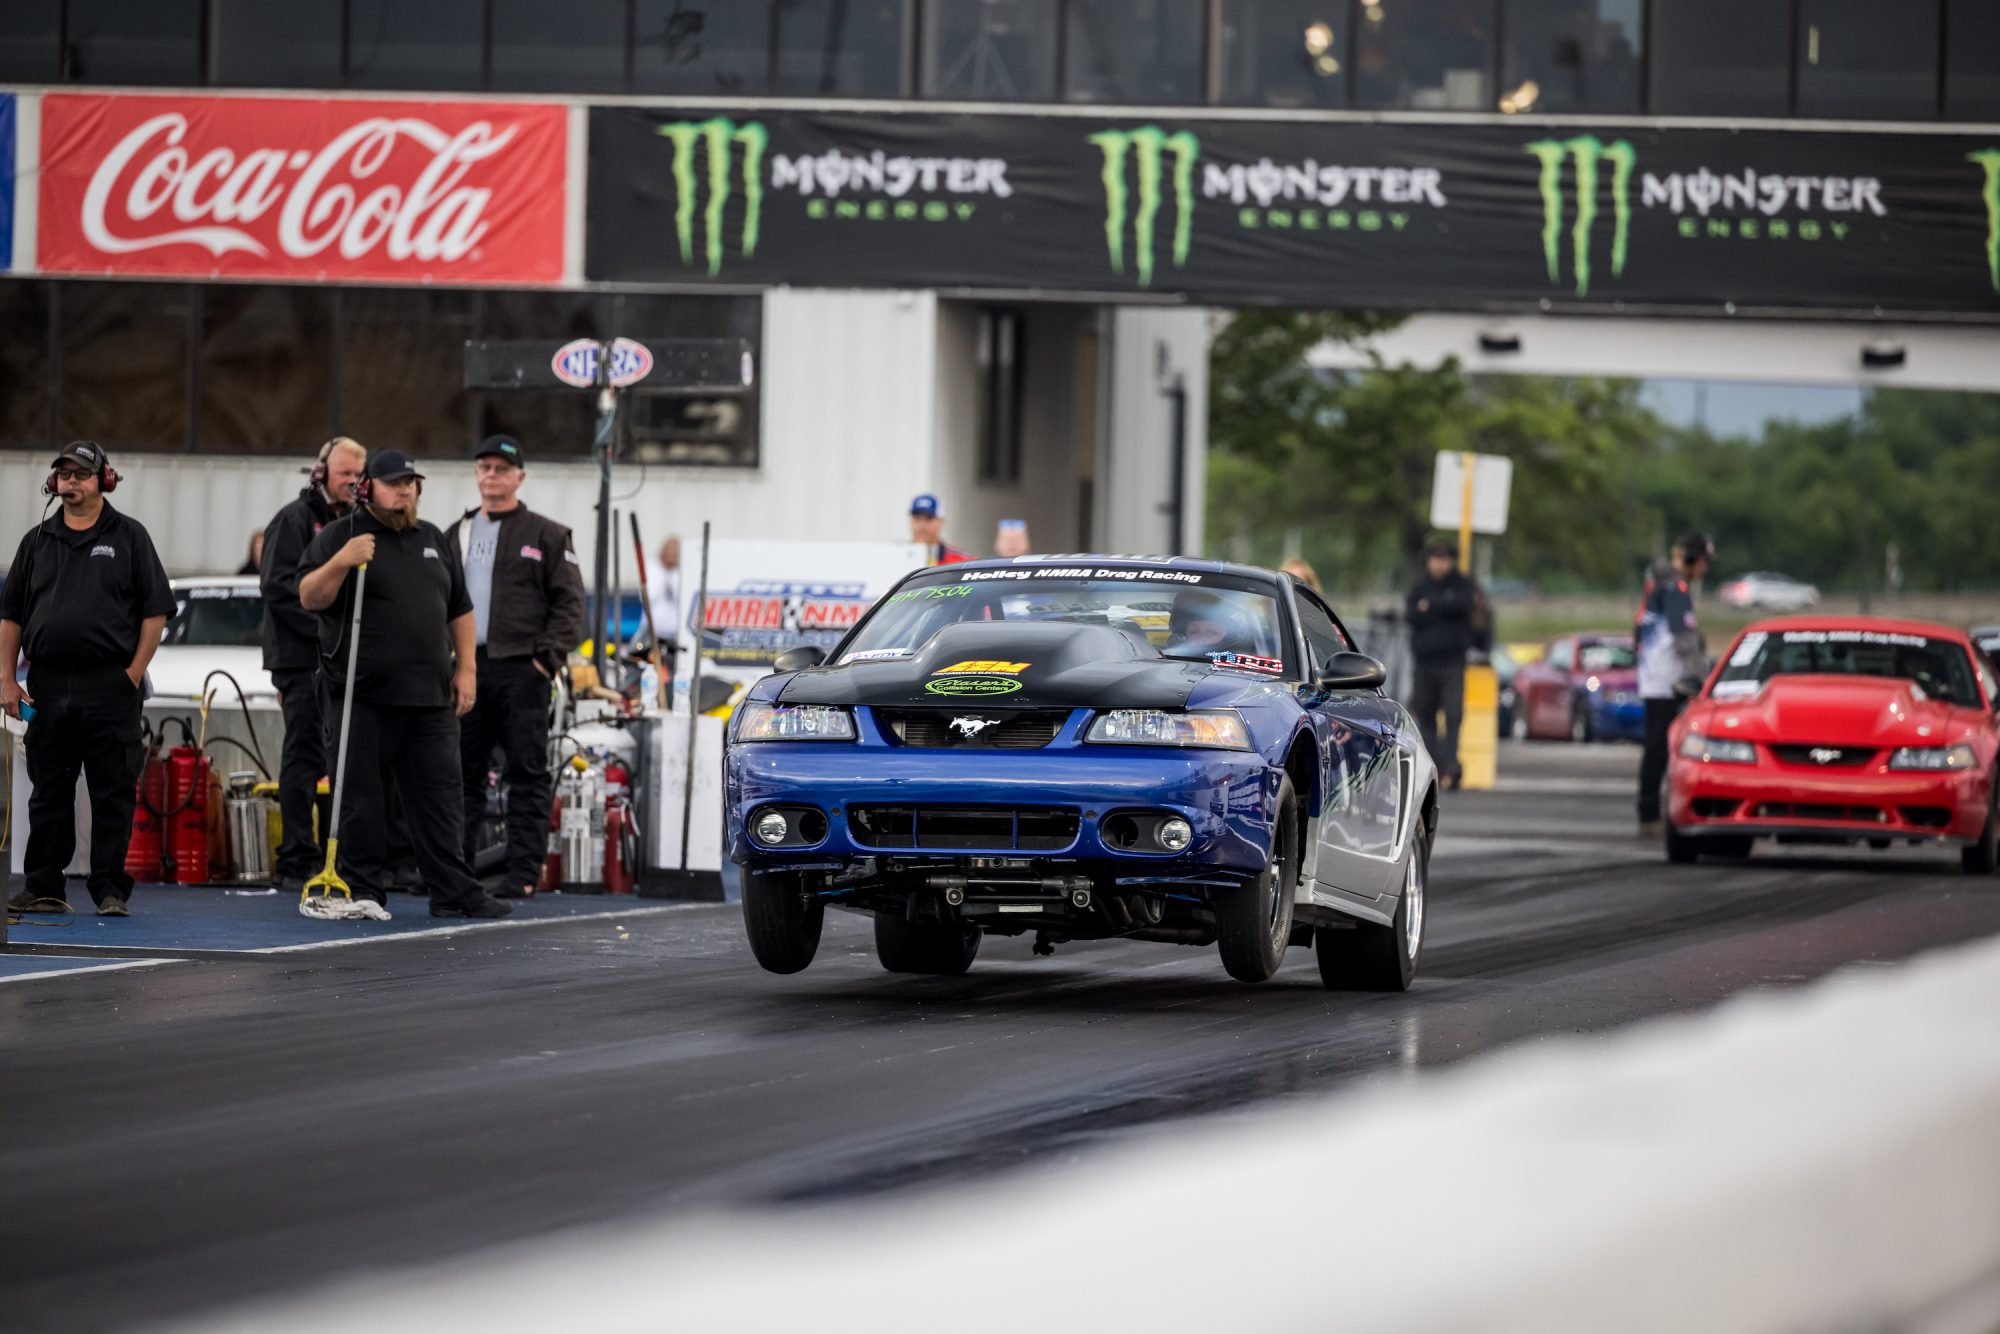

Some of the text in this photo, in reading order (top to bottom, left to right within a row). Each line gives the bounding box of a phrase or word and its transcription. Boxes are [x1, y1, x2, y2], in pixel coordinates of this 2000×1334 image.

[81, 113, 519, 261] Coca-Cola
[771, 148, 1013, 197] MONSTER
[1202, 157, 1447, 206] MONSTER
[1641, 167, 1887, 216] MONSTER
[806, 200, 976, 220] ENERGY
[1239, 208, 1410, 230] ENERGY
[1678, 217, 1849, 240] ENERGY
[961, 568, 1203, 584] Holley NMRA Drag Racing
